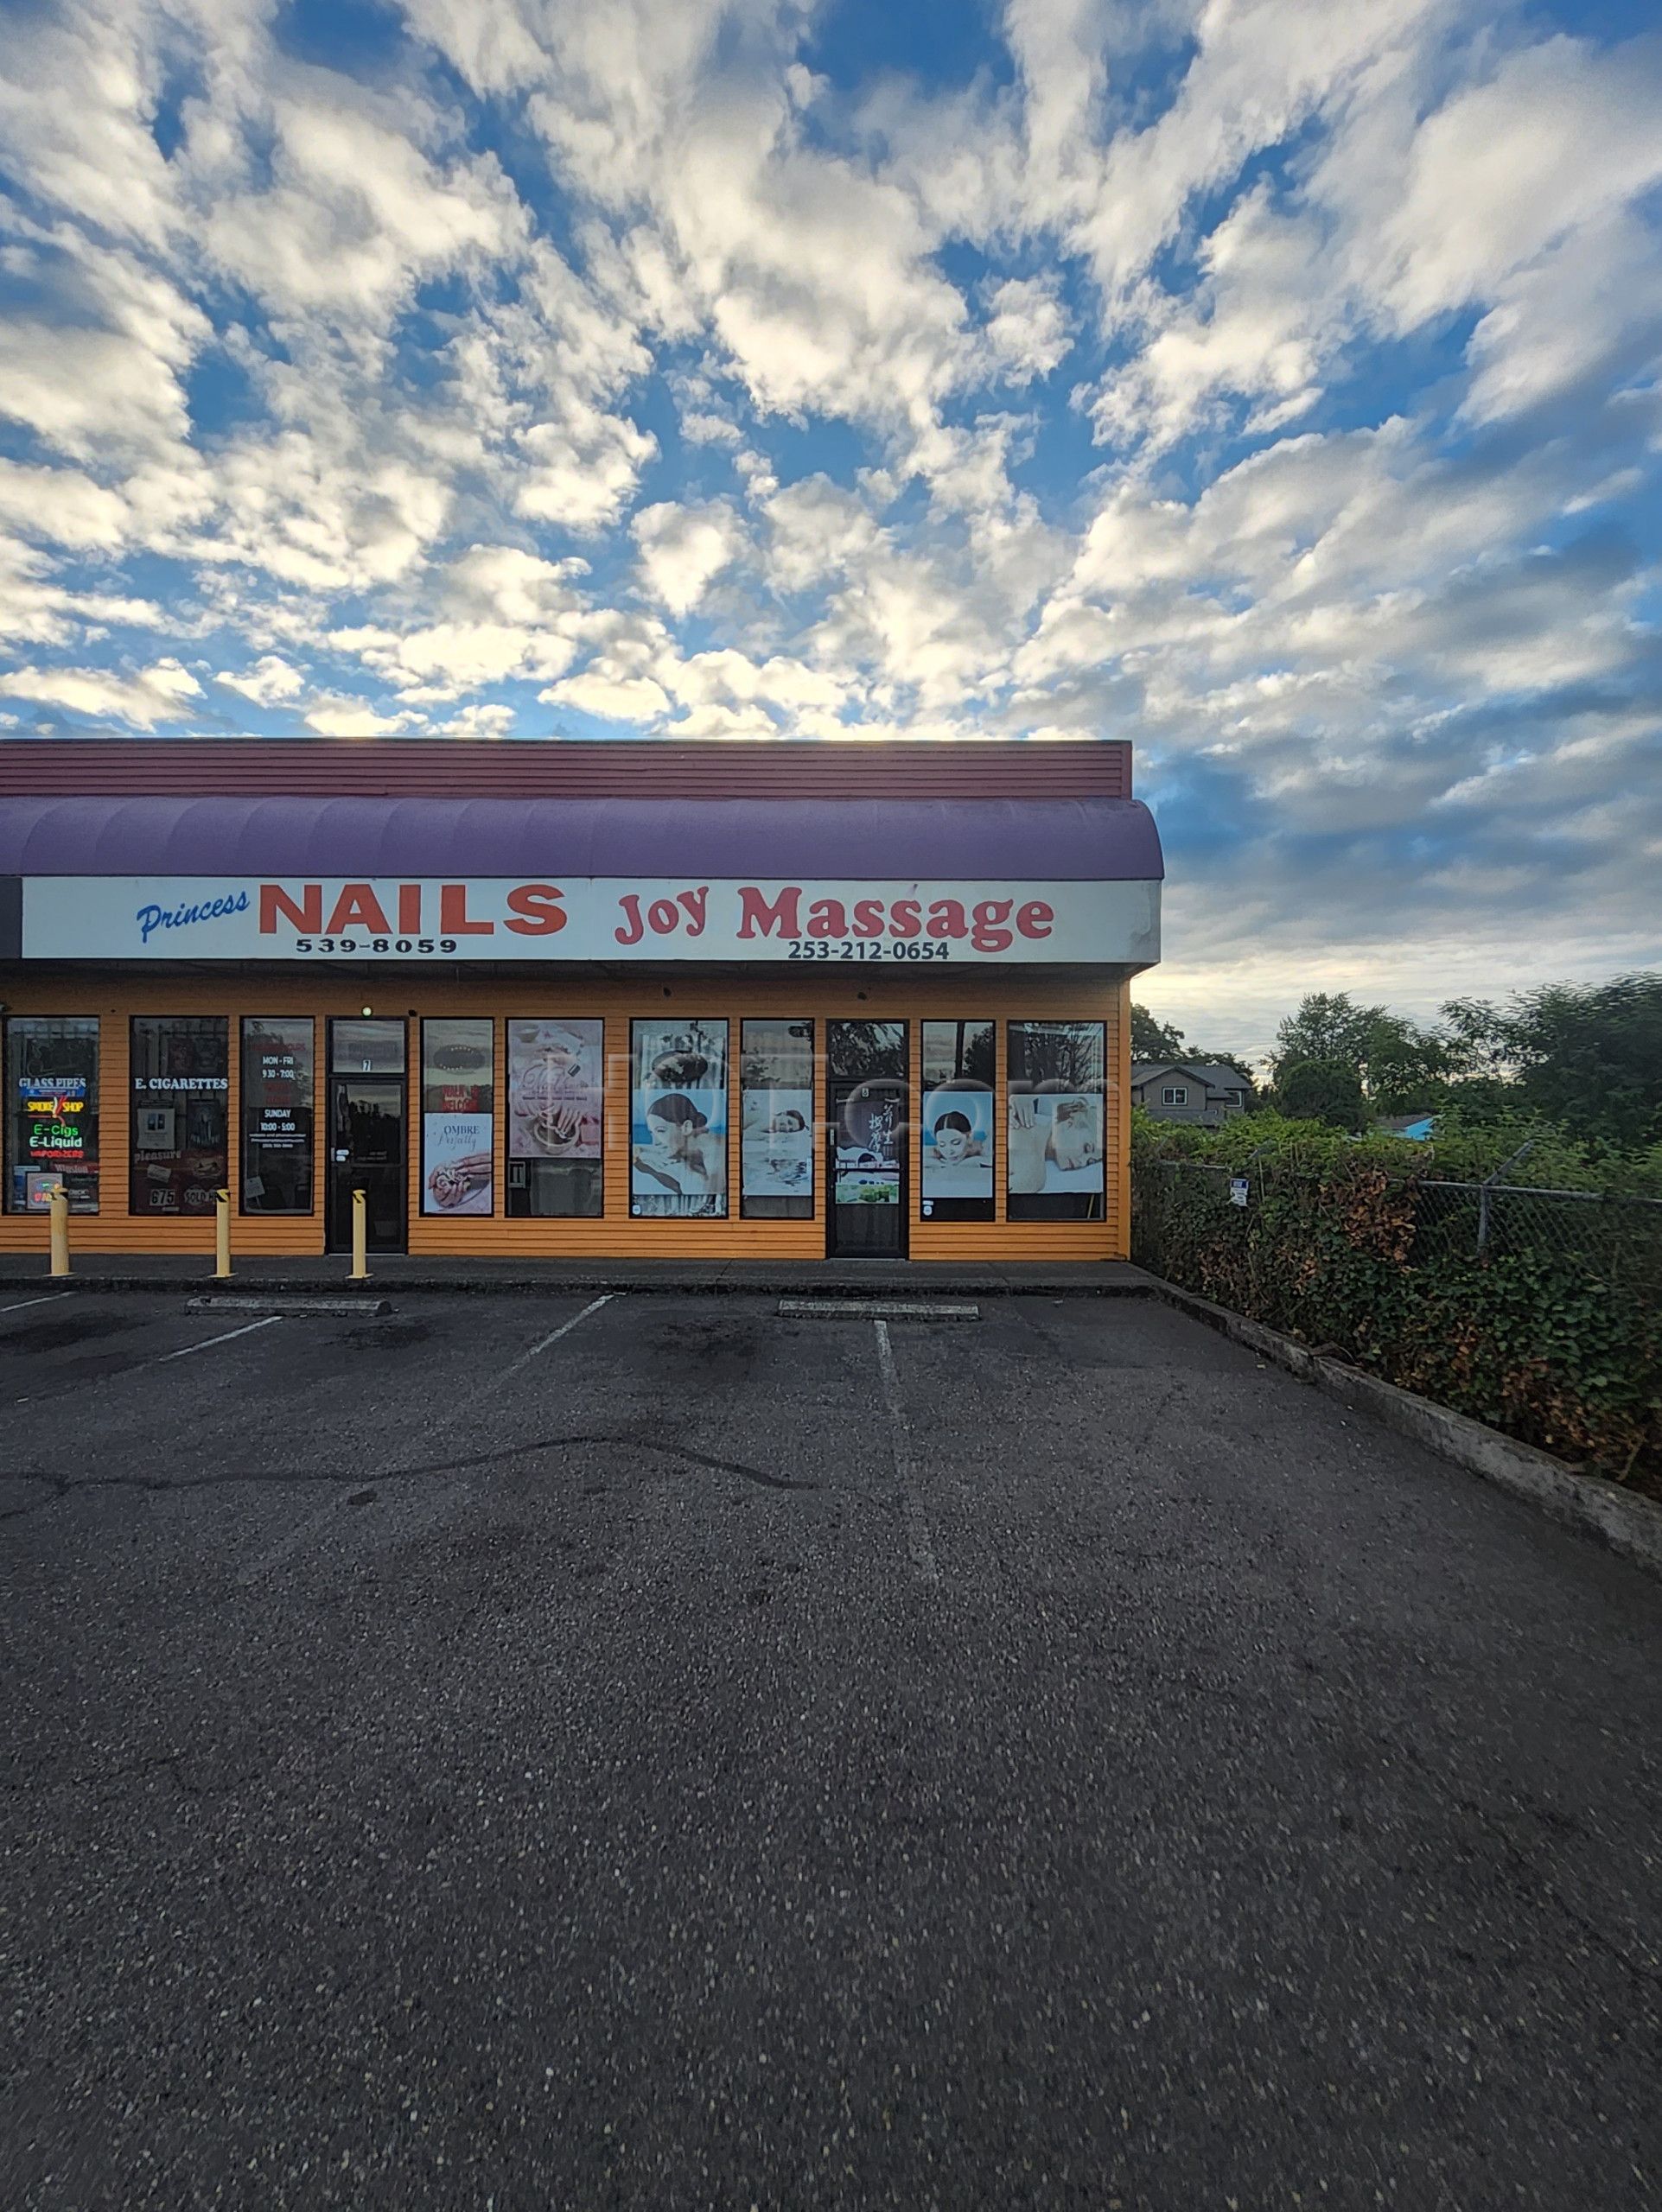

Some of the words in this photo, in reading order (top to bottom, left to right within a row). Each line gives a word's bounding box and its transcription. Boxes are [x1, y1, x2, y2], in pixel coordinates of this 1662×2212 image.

[137, 891, 251, 943] Princess
[259, 884, 568, 935] NAILS
[614, 887, 709, 944] Joy
[736, 887, 1054, 952] Massage
[296, 938, 456, 953] 539-8059
[788, 941, 950, 960] 253-212-0654
[262, 1056, 278, 1065] MON
[283, 1056, 294, 1065] FRI
[18, 1077, 54, 1088] GLASS
[55, 1077, 86, 1089] PIPES
[149, 1077, 228, 1090] CIGARETTES
[62, 1102, 84, 1112] SHOP
[264, 1109, 291, 1118] SUNDAY
[34, 1124, 79, 1137] E-Cigs
[260, 1122, 277, 1131] 10:00
[281, 1122, 296, 1131] 5:00
[443, 1125, 481, 1135] OMBRE
[29, 1136, 83, 1148] E-Liquid
